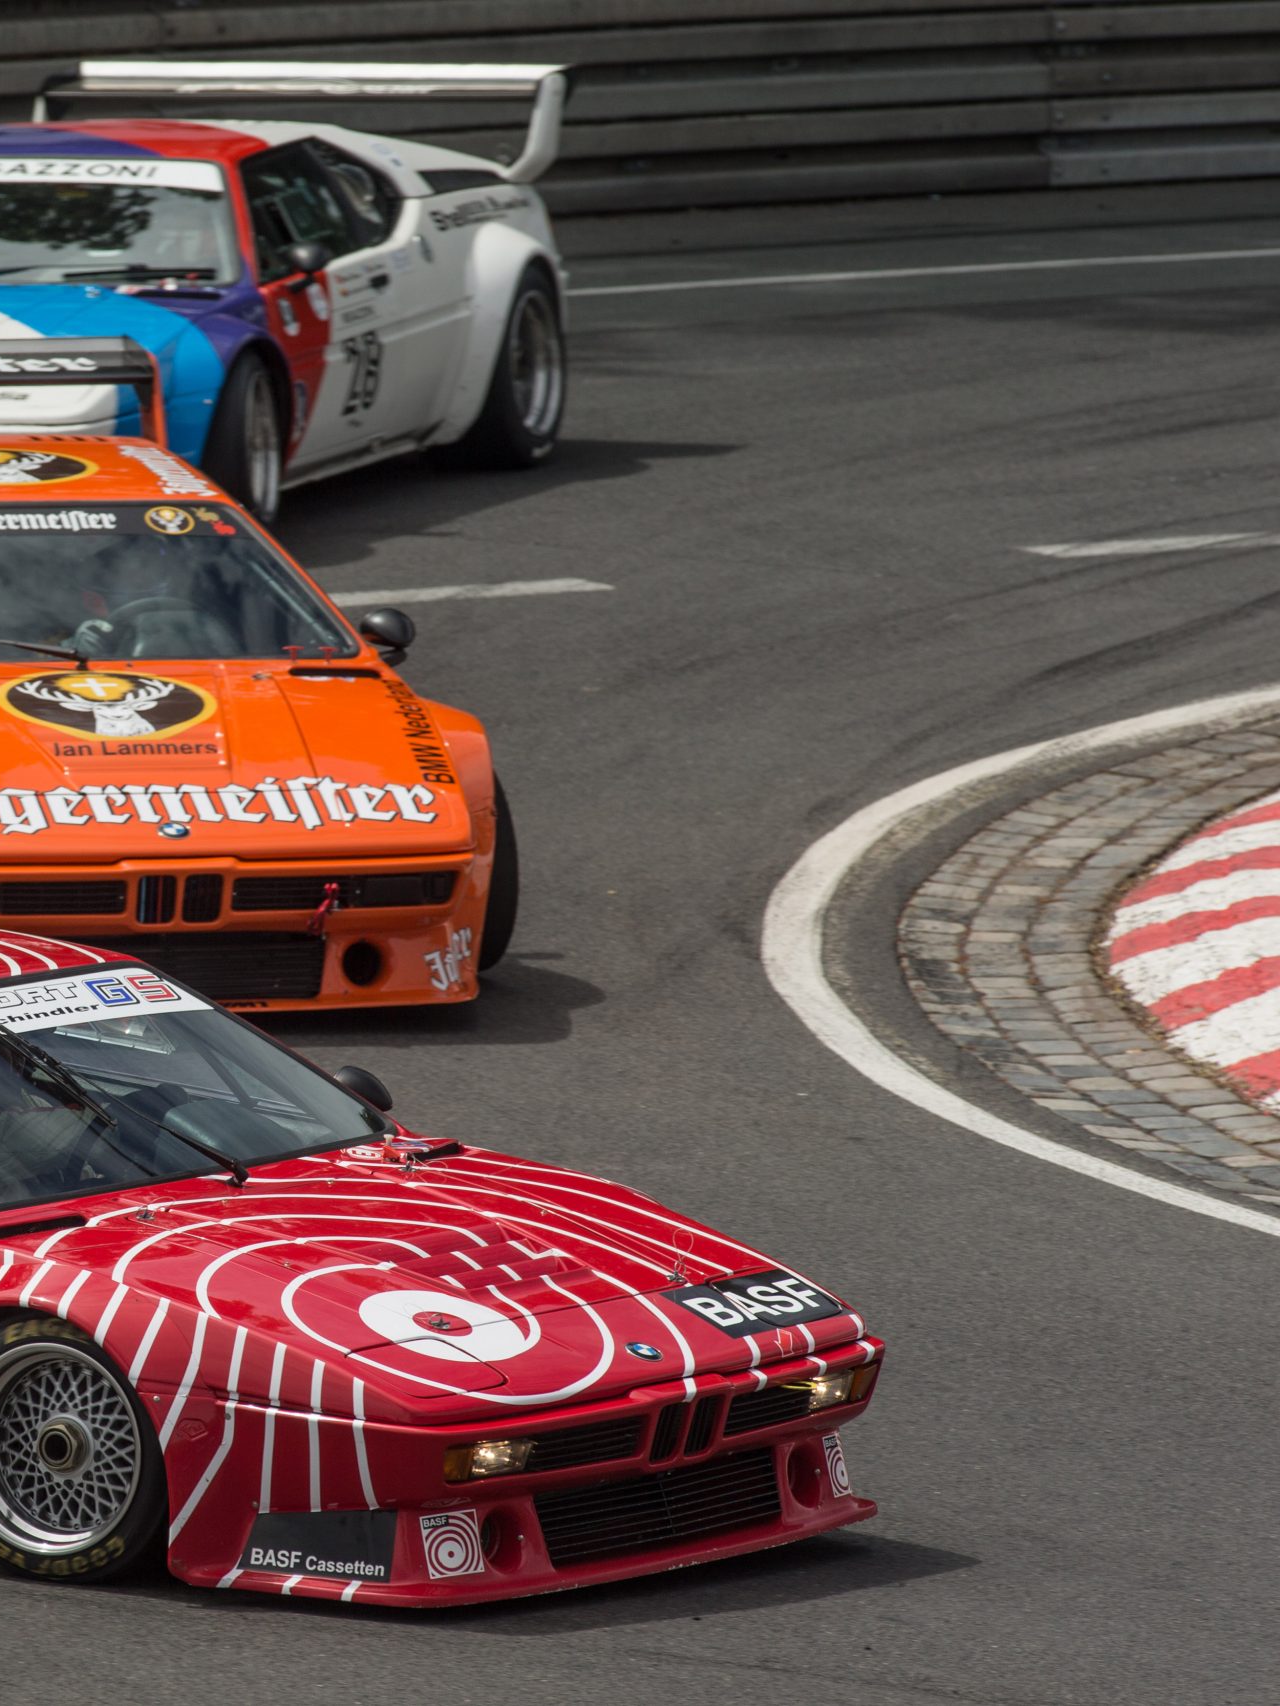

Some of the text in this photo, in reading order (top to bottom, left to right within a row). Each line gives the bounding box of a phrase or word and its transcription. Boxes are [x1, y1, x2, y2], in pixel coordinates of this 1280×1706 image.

[100, 740, 219, 757] Lammers
[407, 741, 455, 784] BMW
[682, 1277, 820, 1328] BASF
[423, 1516, 449, 1529] BASF
[250, 1547, 386, 1577] BASF Cassetten
